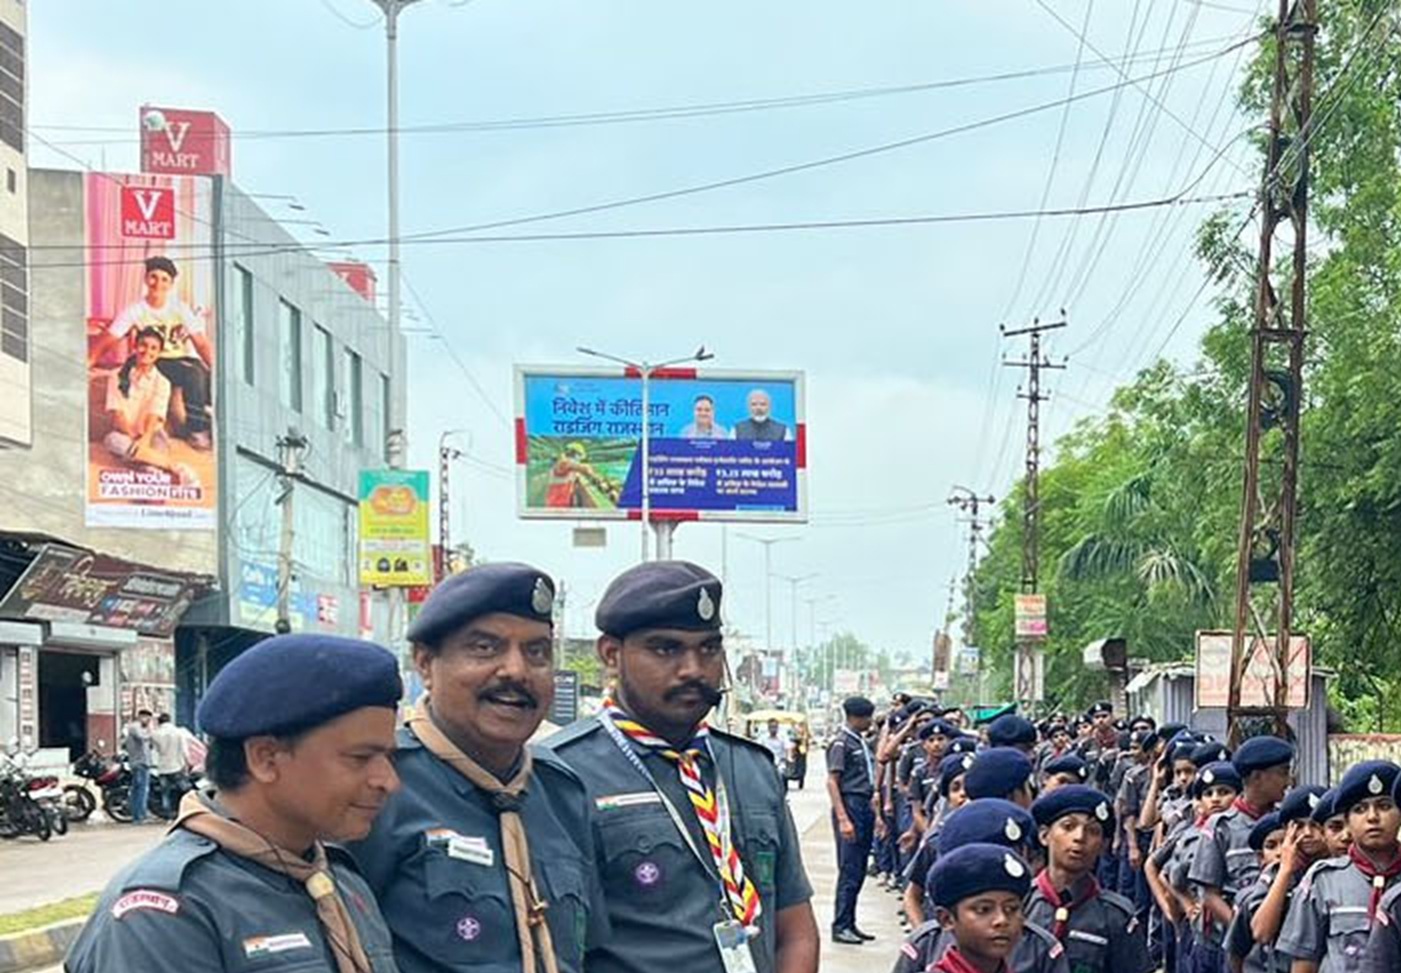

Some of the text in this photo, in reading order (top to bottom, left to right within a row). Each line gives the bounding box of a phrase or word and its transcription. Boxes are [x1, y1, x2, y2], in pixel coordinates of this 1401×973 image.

[164, 121, 191, 152] V
[151, 151, 200, 168] MART
[134, 190, 164, 221] V
[124, 219, 174, 236] MART
[606, 420, 665, 436] राजस्ान
[101, 485, 168, 498] FASHION
